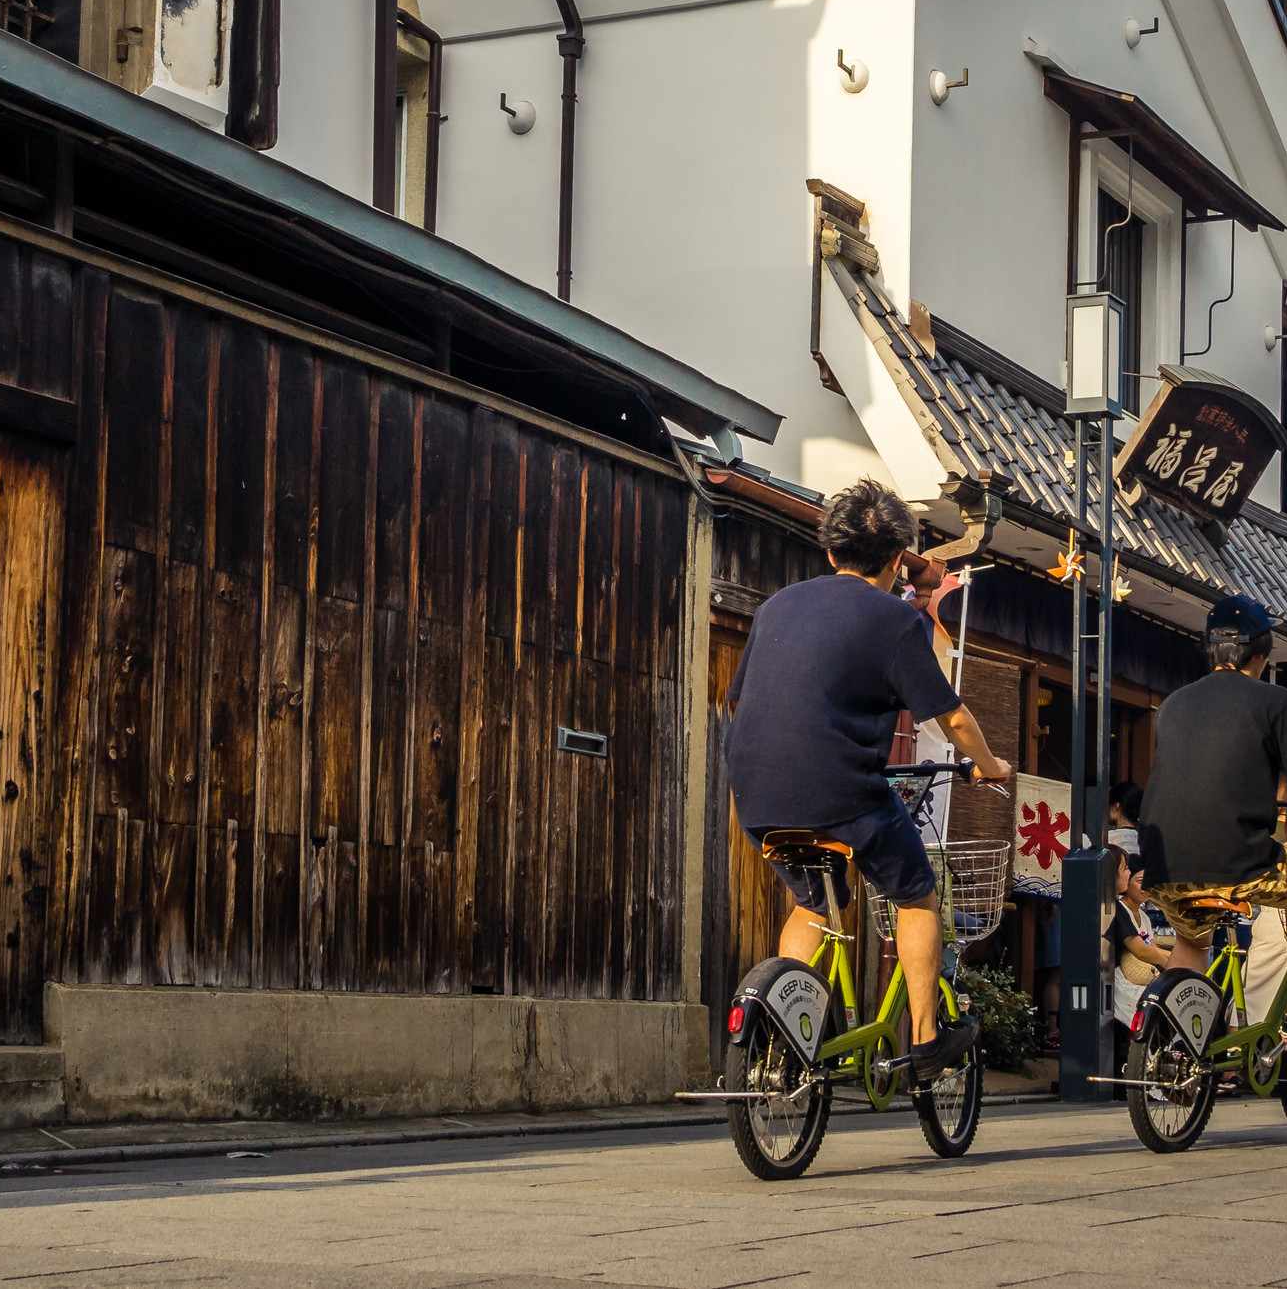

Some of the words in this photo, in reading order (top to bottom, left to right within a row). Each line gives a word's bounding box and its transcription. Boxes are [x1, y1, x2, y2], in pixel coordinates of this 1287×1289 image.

[1017, 801, 1070, 870] 氷
[778, 979, 798, 1003] KEEP
[799, 979, 821, 1000] LEFT
[1174, 986, 1193, 1006] KEEP
[1193, 986, 1213, 1004] LEFT
